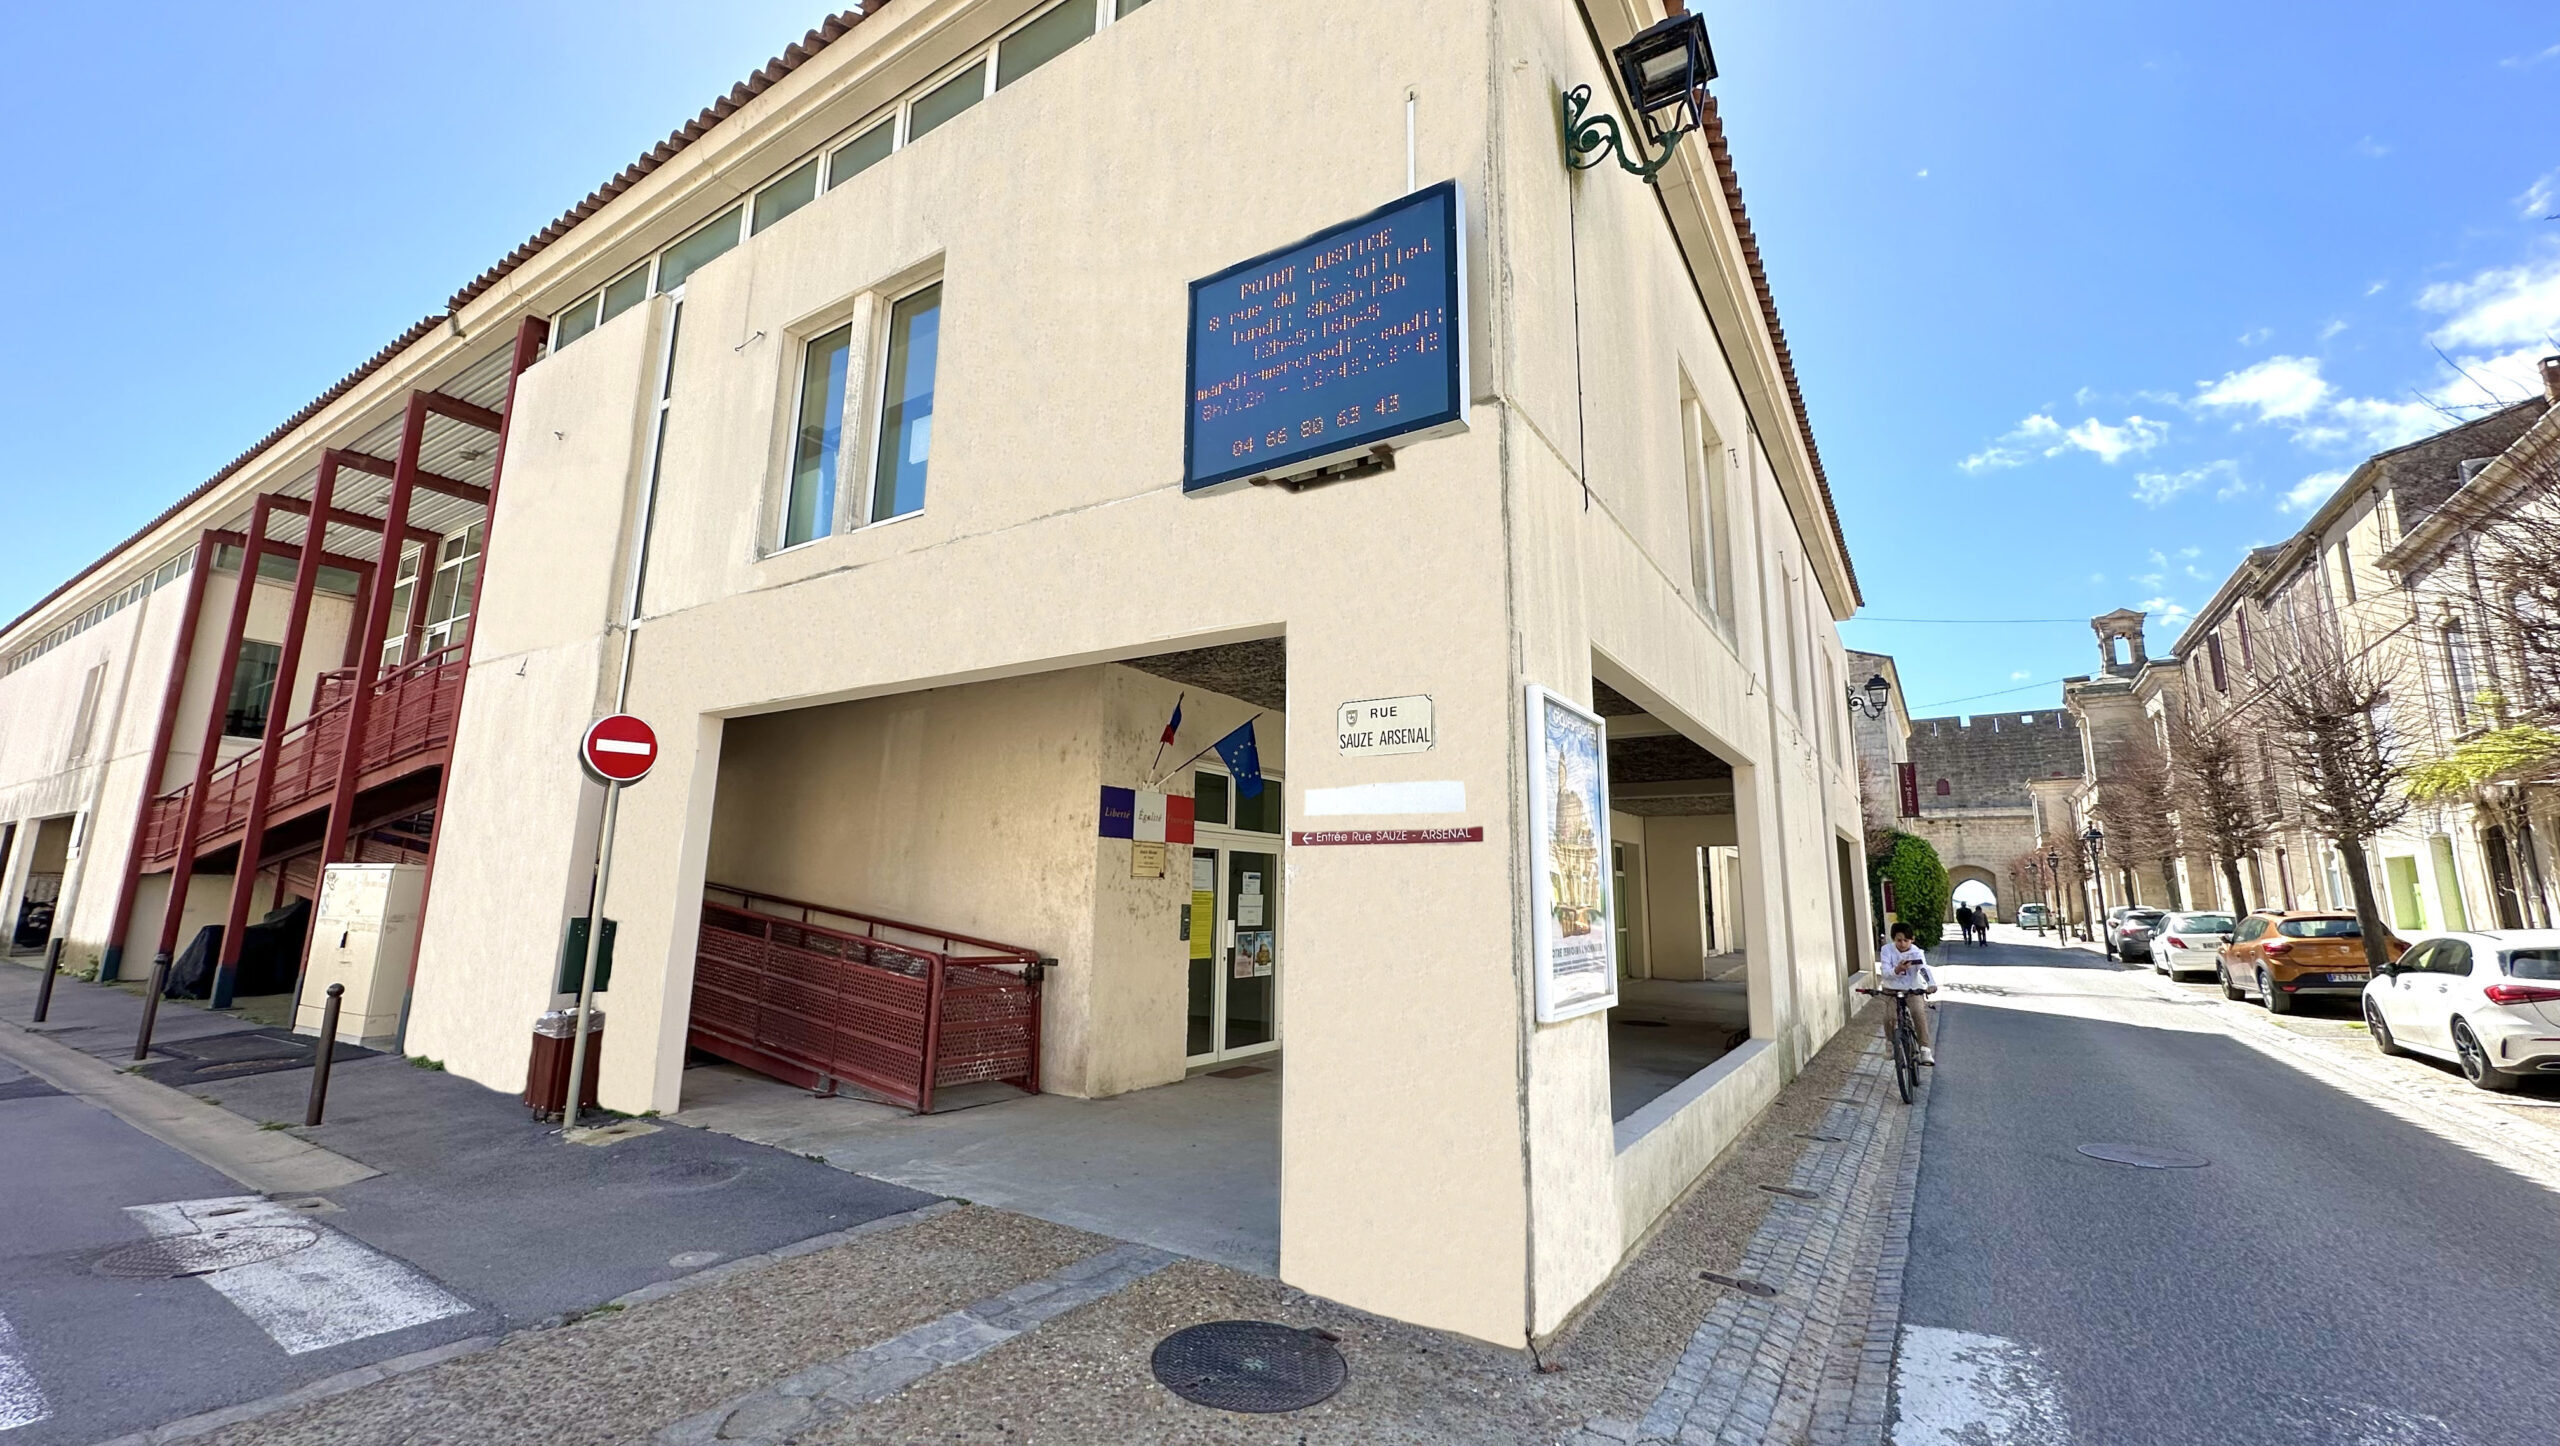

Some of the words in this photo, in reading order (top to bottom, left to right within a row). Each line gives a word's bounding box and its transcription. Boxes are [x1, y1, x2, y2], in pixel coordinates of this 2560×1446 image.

[1240, 266, 1296, 301] POINT
[1306, 228, 1393, 274] JUSTICE
[1208, 316, 1220, 332] 8
[1229, 305, 1263, 326] rue
[1273, 291, 1297, 308] du
[1231, 436, 1254, 458] 04
[1265, 426, 1288, 448] 66
[1300, 416, 1324, 439] 80
[1336, 405, 1361, 428] 63
[1373, 394, 1400, 415] 43
[1369, 706, 1398, 719] RUE
[1339, 731, 1374, 749] SAUZE
[1379, 727, 1431, 746] ARSENAL
[1104, 807, 1131, 819] Liberté
[1138, 808, 1162, 823] Égalité
[1316, 832, 1348, 842] Entrée
[1352, 832, 1372, 842] Rue
[1376, 830, 1408, 841] SAUZE
[1420, 828, 1472, 840] ARSENAL
